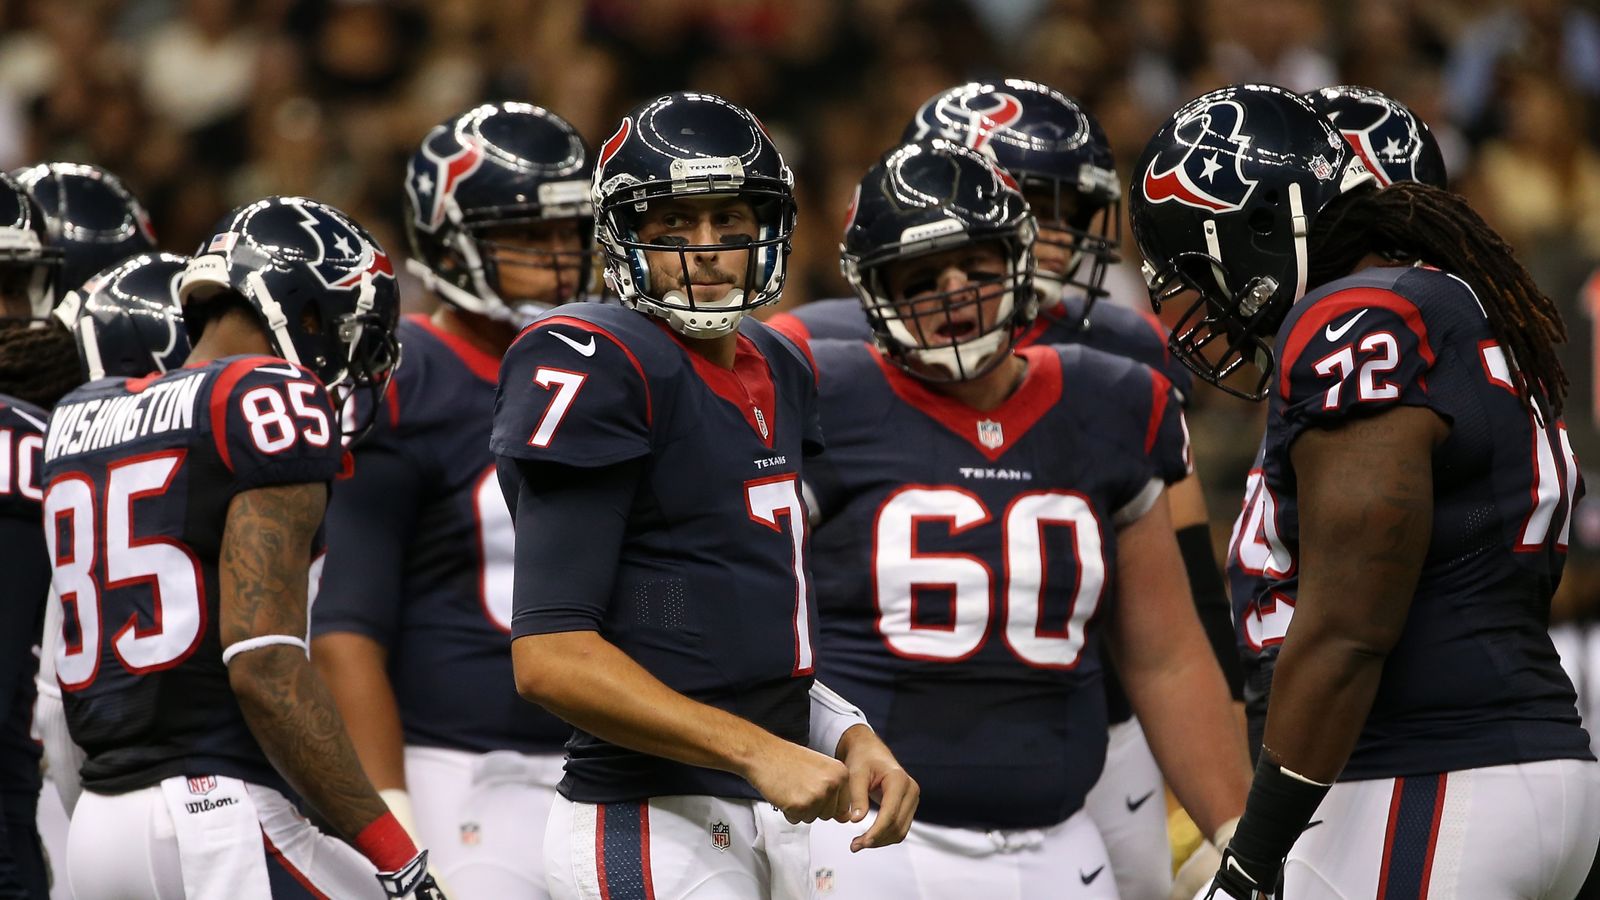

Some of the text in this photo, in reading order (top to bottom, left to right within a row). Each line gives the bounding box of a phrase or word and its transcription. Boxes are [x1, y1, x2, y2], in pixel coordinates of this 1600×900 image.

[527, 366, 588, 448] 7
[1311, 332, 1401, 411] 72
[46, 373, 205, 462] WASHINGTON
[242, 381, 331, 454] 85
[754, 455, 786, 469] TEXANS
[959, 468, 1032, 480] TEXANS
[43, 450, 207, 691] 85
[745, 473, 814, 676] 7
[874, 486, 1106, 668] 60
[185, 797, 234, 814] Wilson
[190, 777, 215, 792] NFL
[713, 834, 729, 846] NFL
